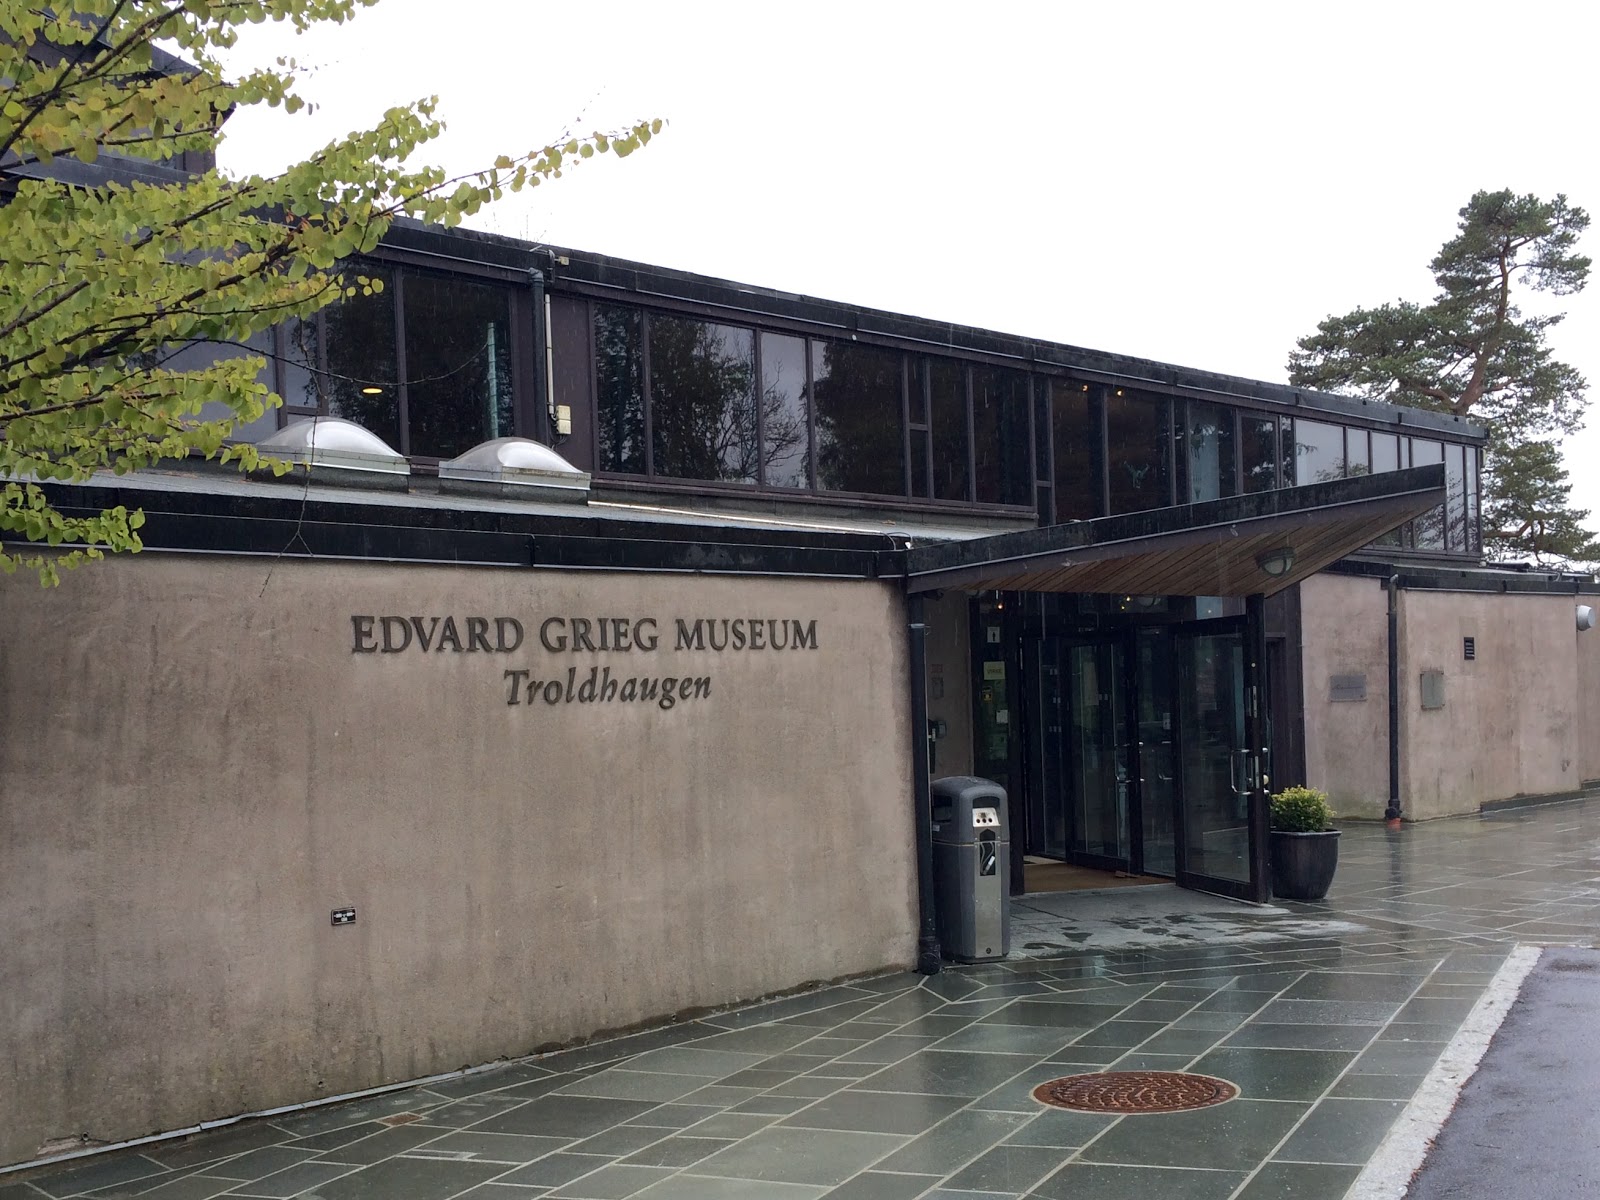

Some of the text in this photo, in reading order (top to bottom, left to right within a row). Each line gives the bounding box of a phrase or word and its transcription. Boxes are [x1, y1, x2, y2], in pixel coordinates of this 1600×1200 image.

[351, 615, 819, 654] EDVARD GRIEG MUSEUM
[503, 666, 712, 710] Troldhaugen
